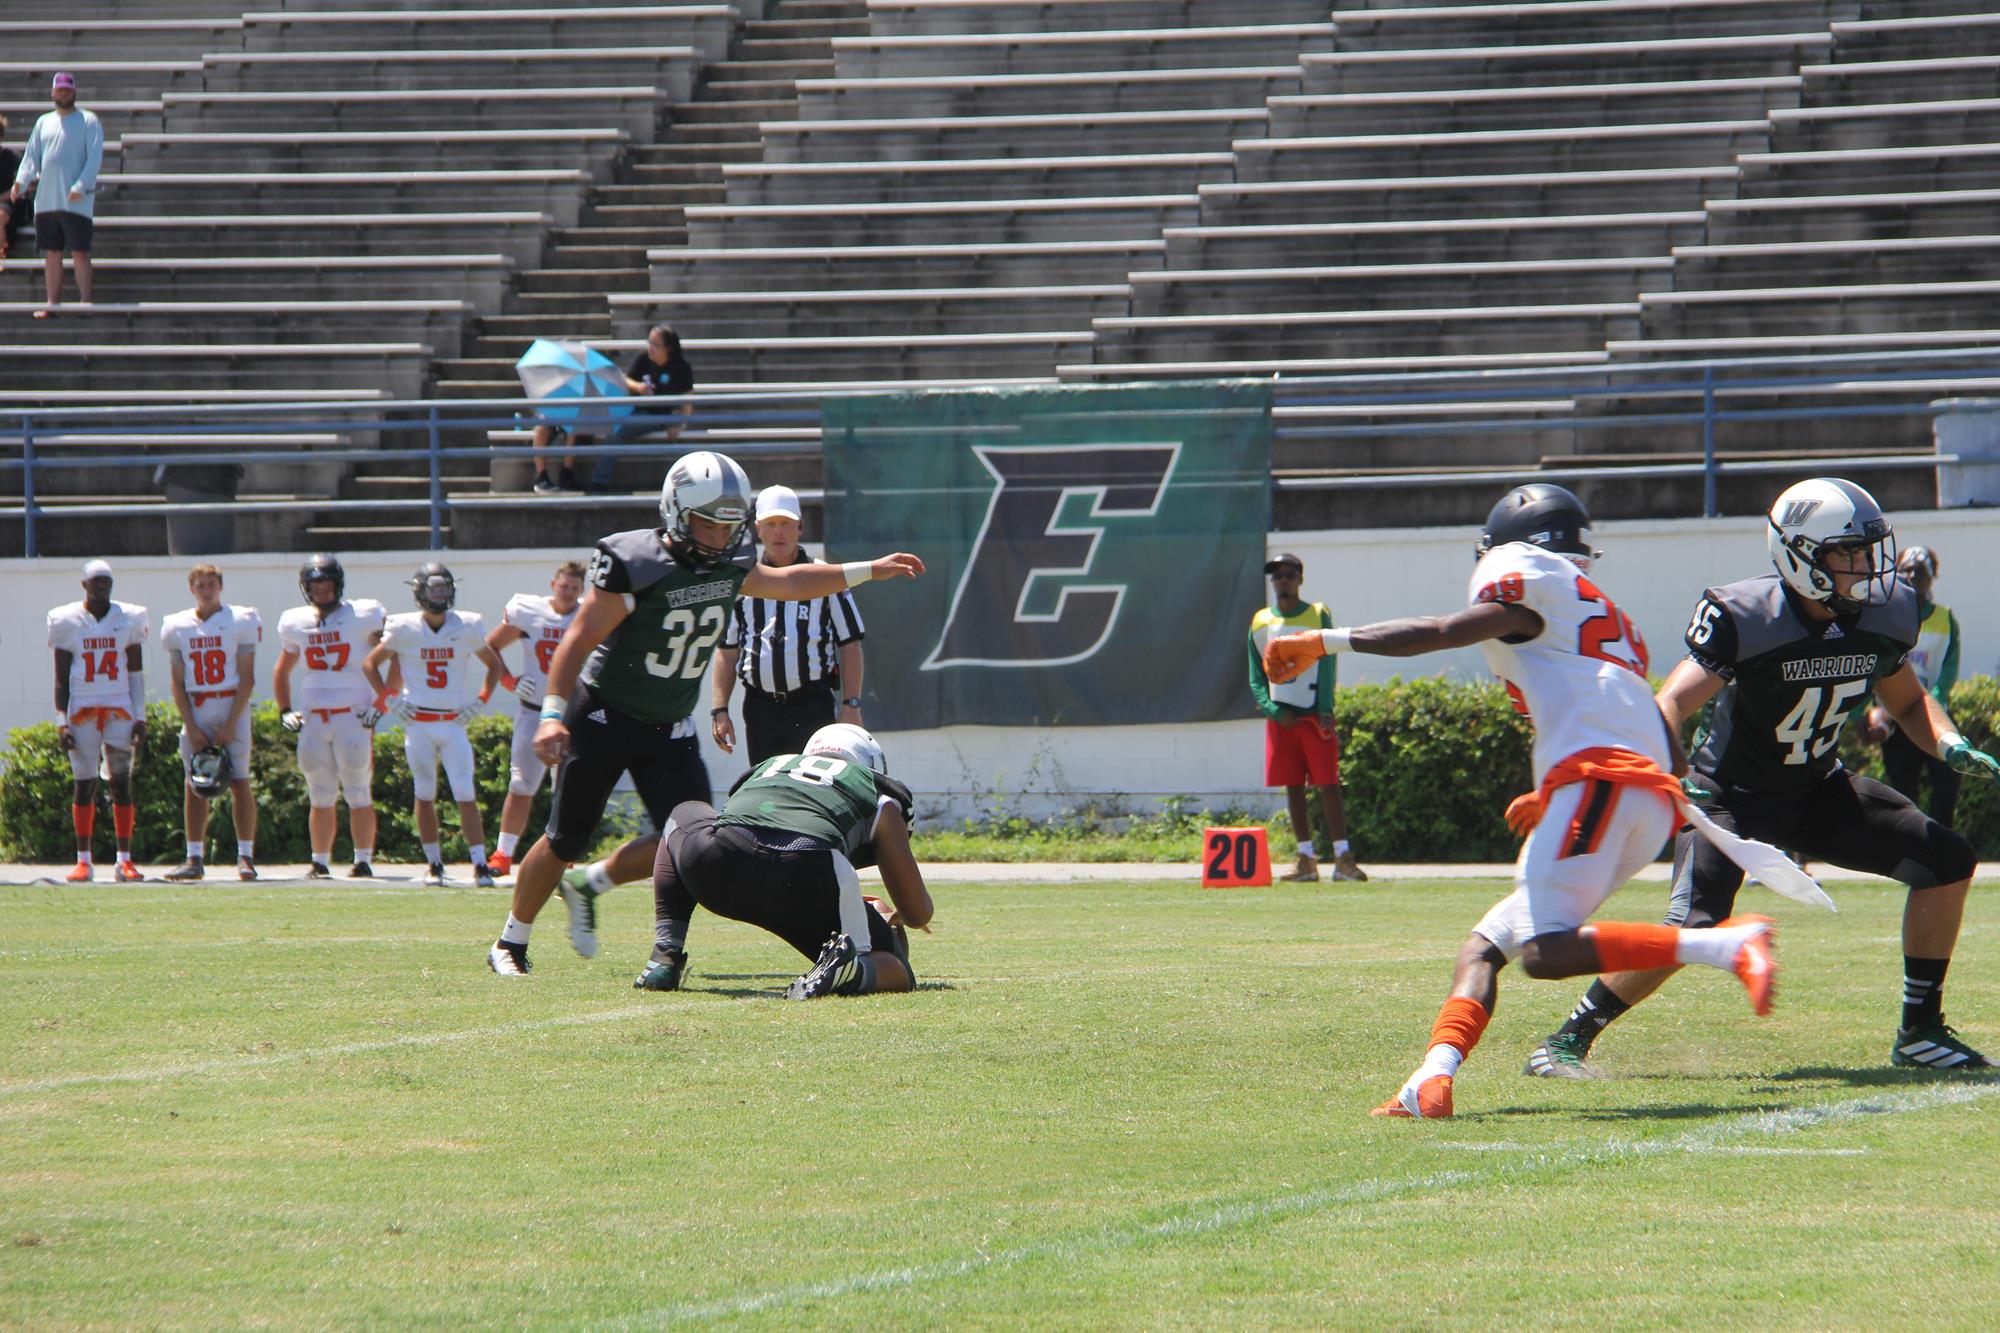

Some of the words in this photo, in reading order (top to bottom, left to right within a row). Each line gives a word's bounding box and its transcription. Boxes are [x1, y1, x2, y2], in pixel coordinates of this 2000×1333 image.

[1780, 499, 1823, 527] W
[919, 441, 1183, 672] E
[798, 605, 809, 620] R
[83, 636, 116, 649] UNION
[189, 636, 222, 649] UNION
[308, 630, 340, 645] UNION
[644, 605, 725, 679] 32
[81, 651, 119, 683] 14
[189, 650, 226, 685] 18
[305, 643, 351, 671] 67
[420, 647, 454, 660] UNION
[1782, 654, 1878, 681] WARRIORS
[425, 661, 448, 689] 5
[1776, 679, 1866, 765] 45
[1207, 833, 1257, 880] 20
